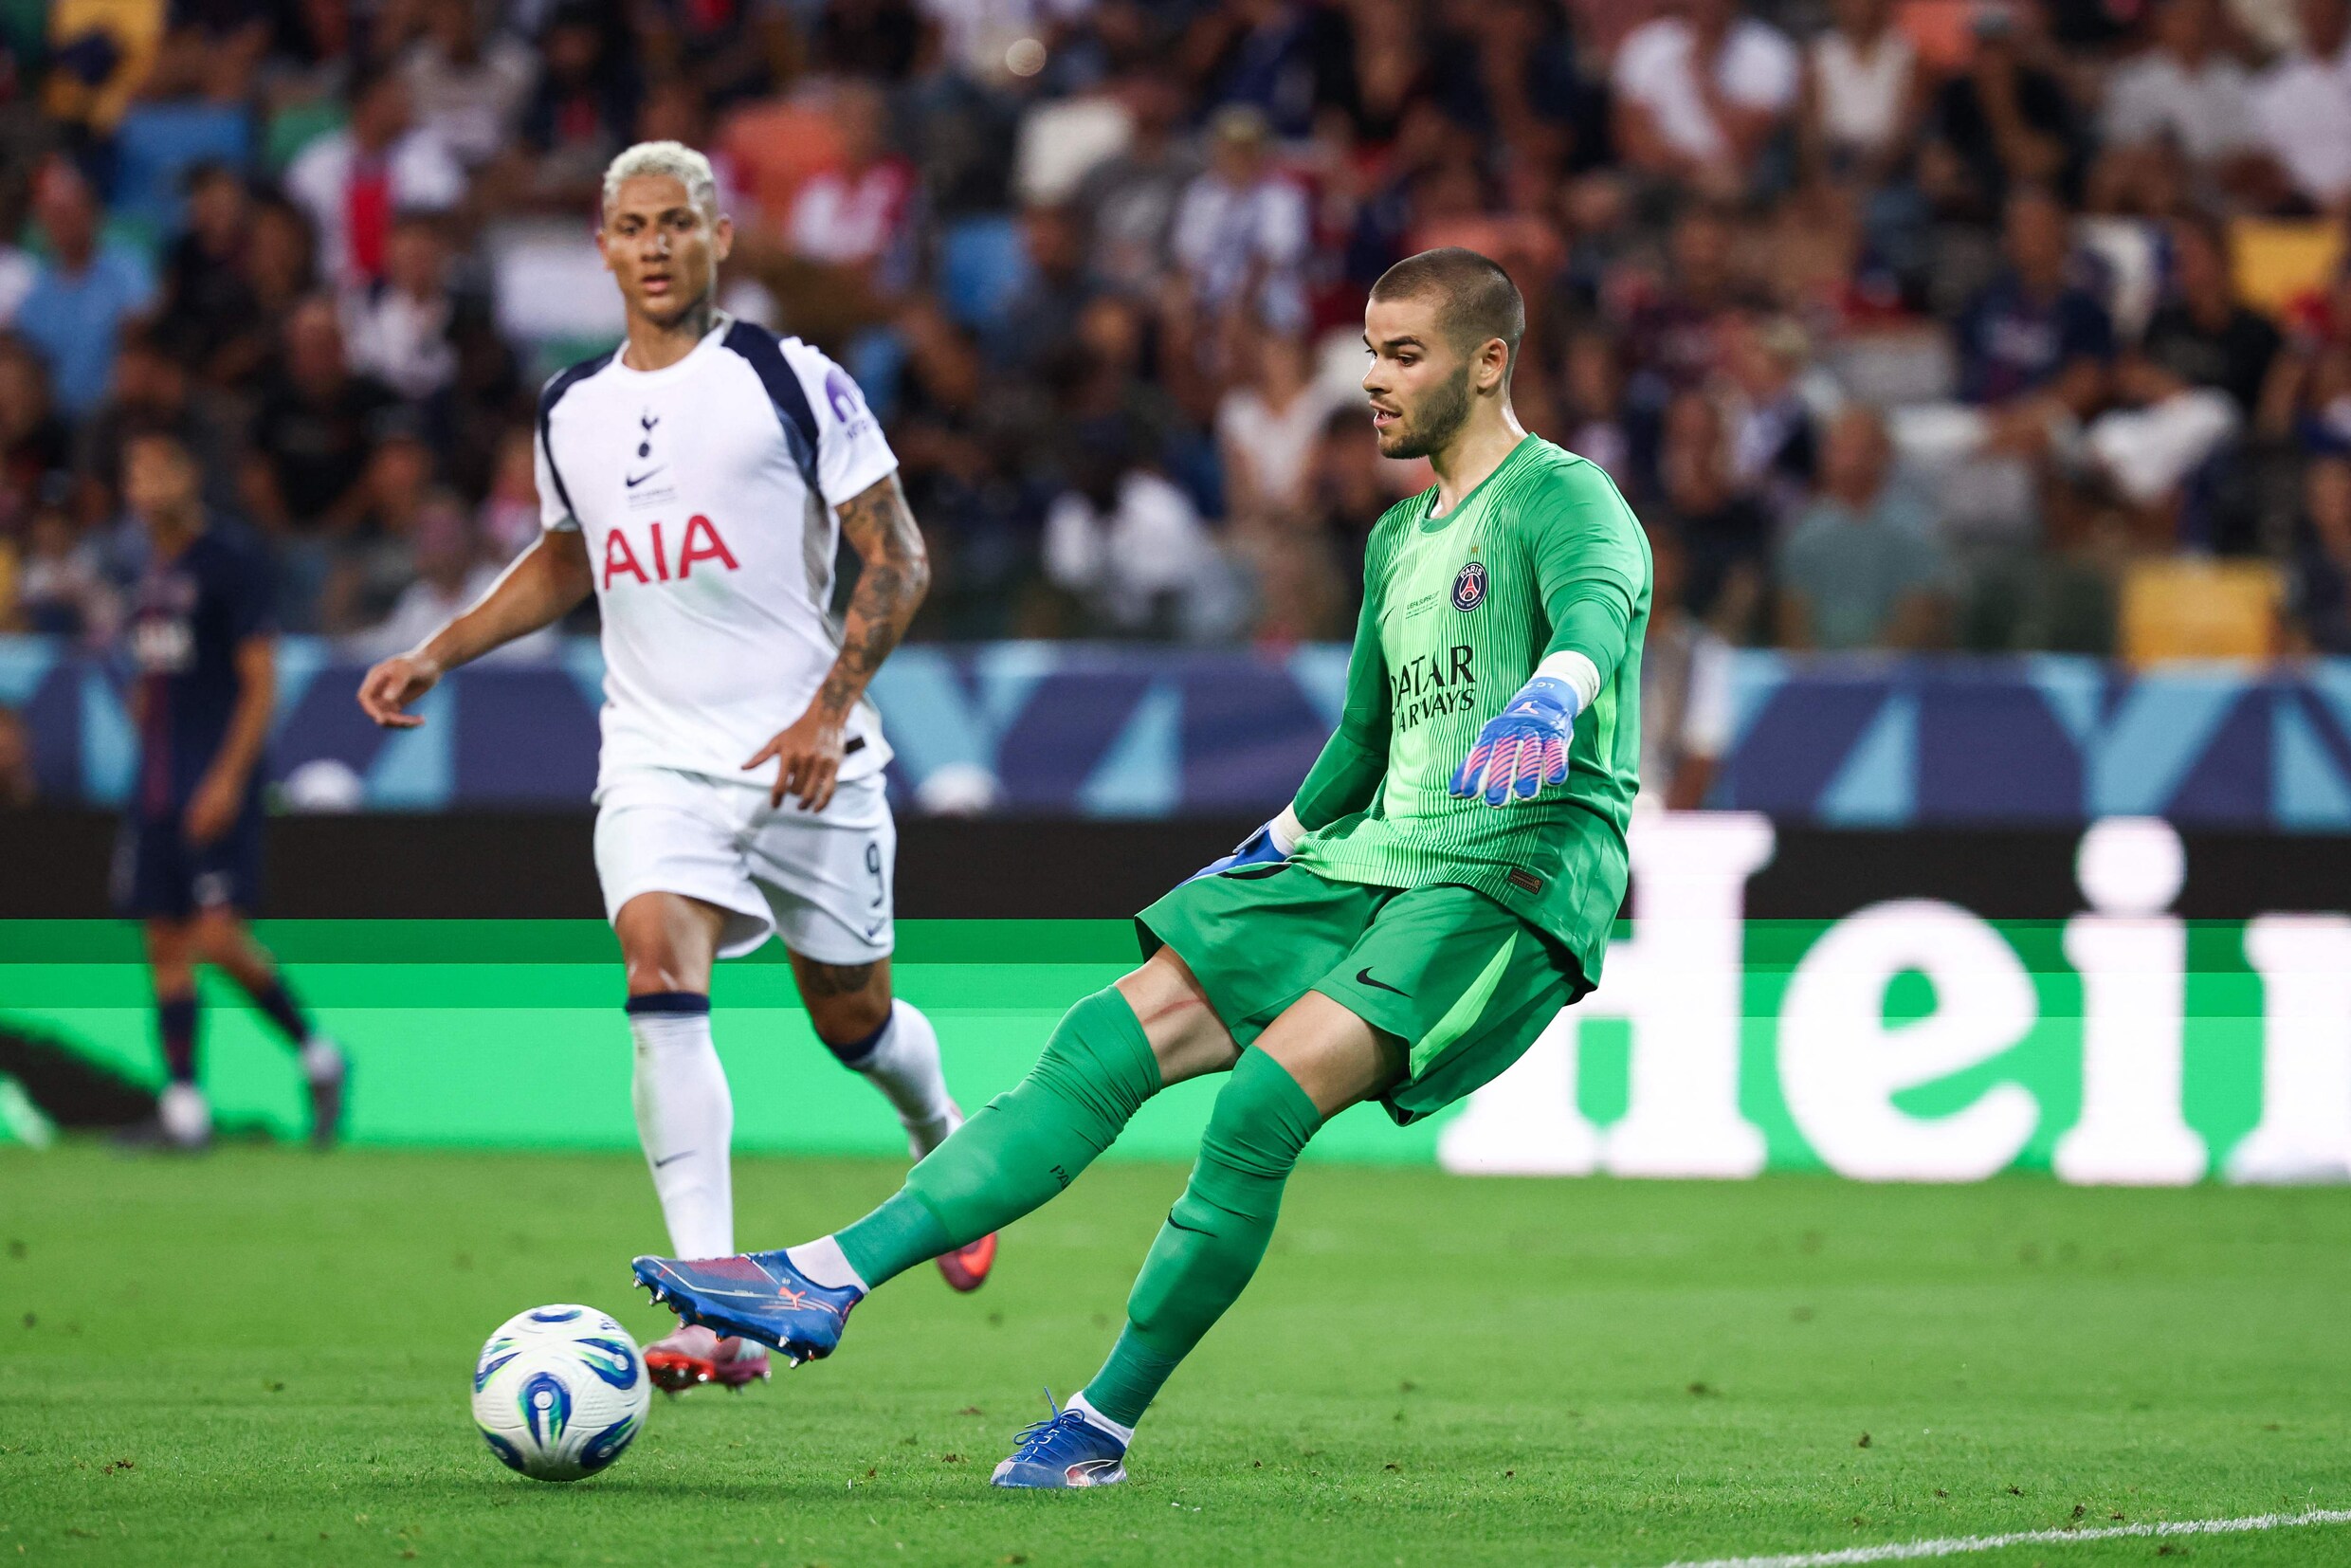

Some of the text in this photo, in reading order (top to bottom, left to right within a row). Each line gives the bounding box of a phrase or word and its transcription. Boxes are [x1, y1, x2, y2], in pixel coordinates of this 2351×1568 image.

[604, 514, 739, 593] AIA
[1460, 565, 1483, 579] PARIS
[866, 840, 884, 908] 9
